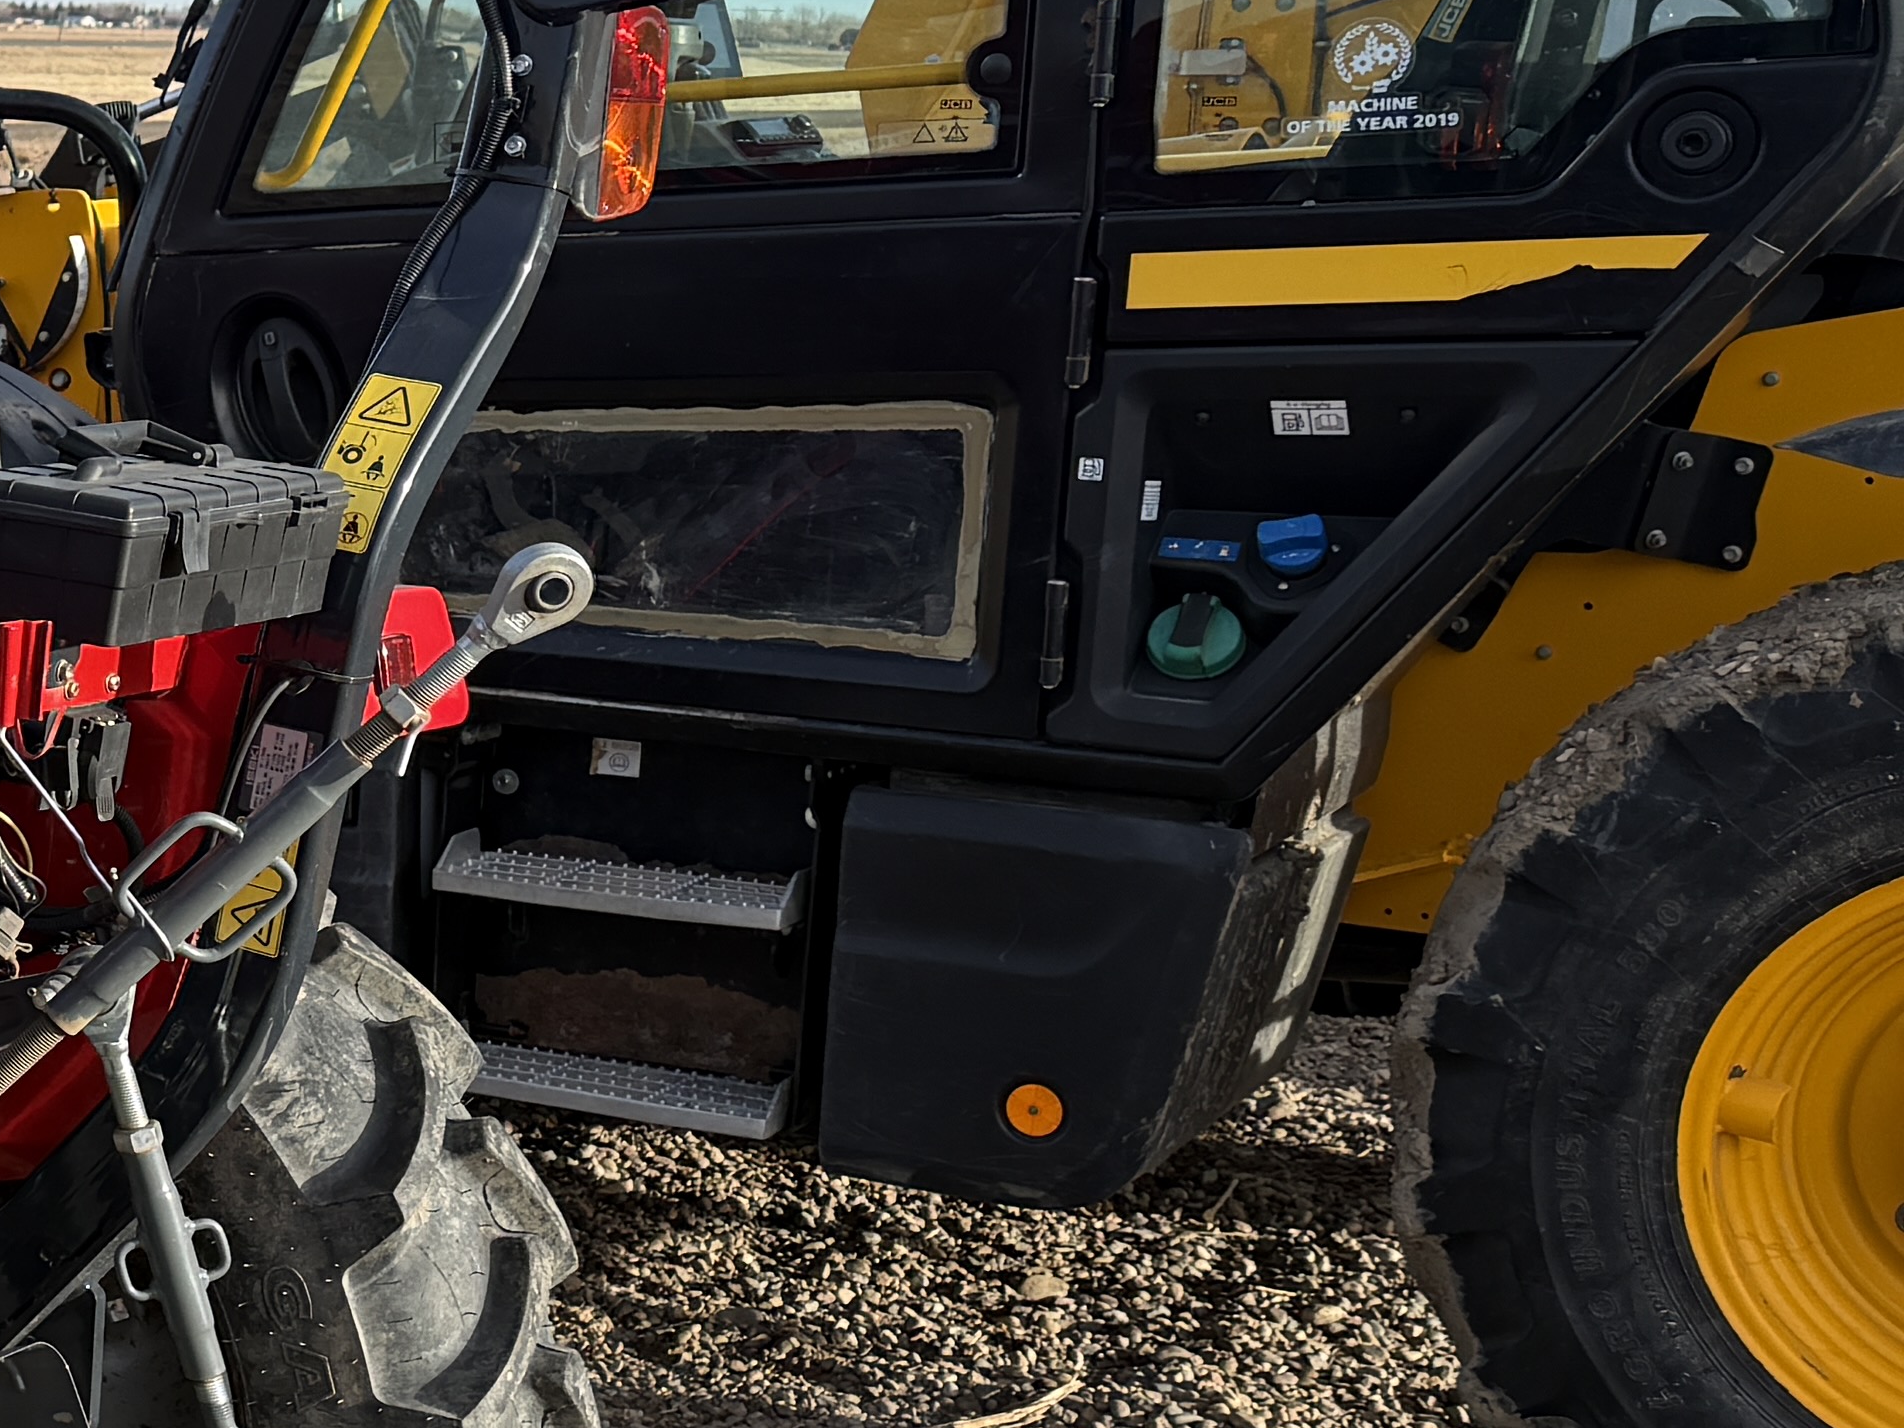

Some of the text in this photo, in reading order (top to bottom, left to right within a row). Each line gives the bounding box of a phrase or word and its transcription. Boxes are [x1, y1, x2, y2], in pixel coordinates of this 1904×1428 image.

[1326, 96, 1419, 113] MACHINE
[1286, 113, 1460, 134] OF THE YEAR 2019
